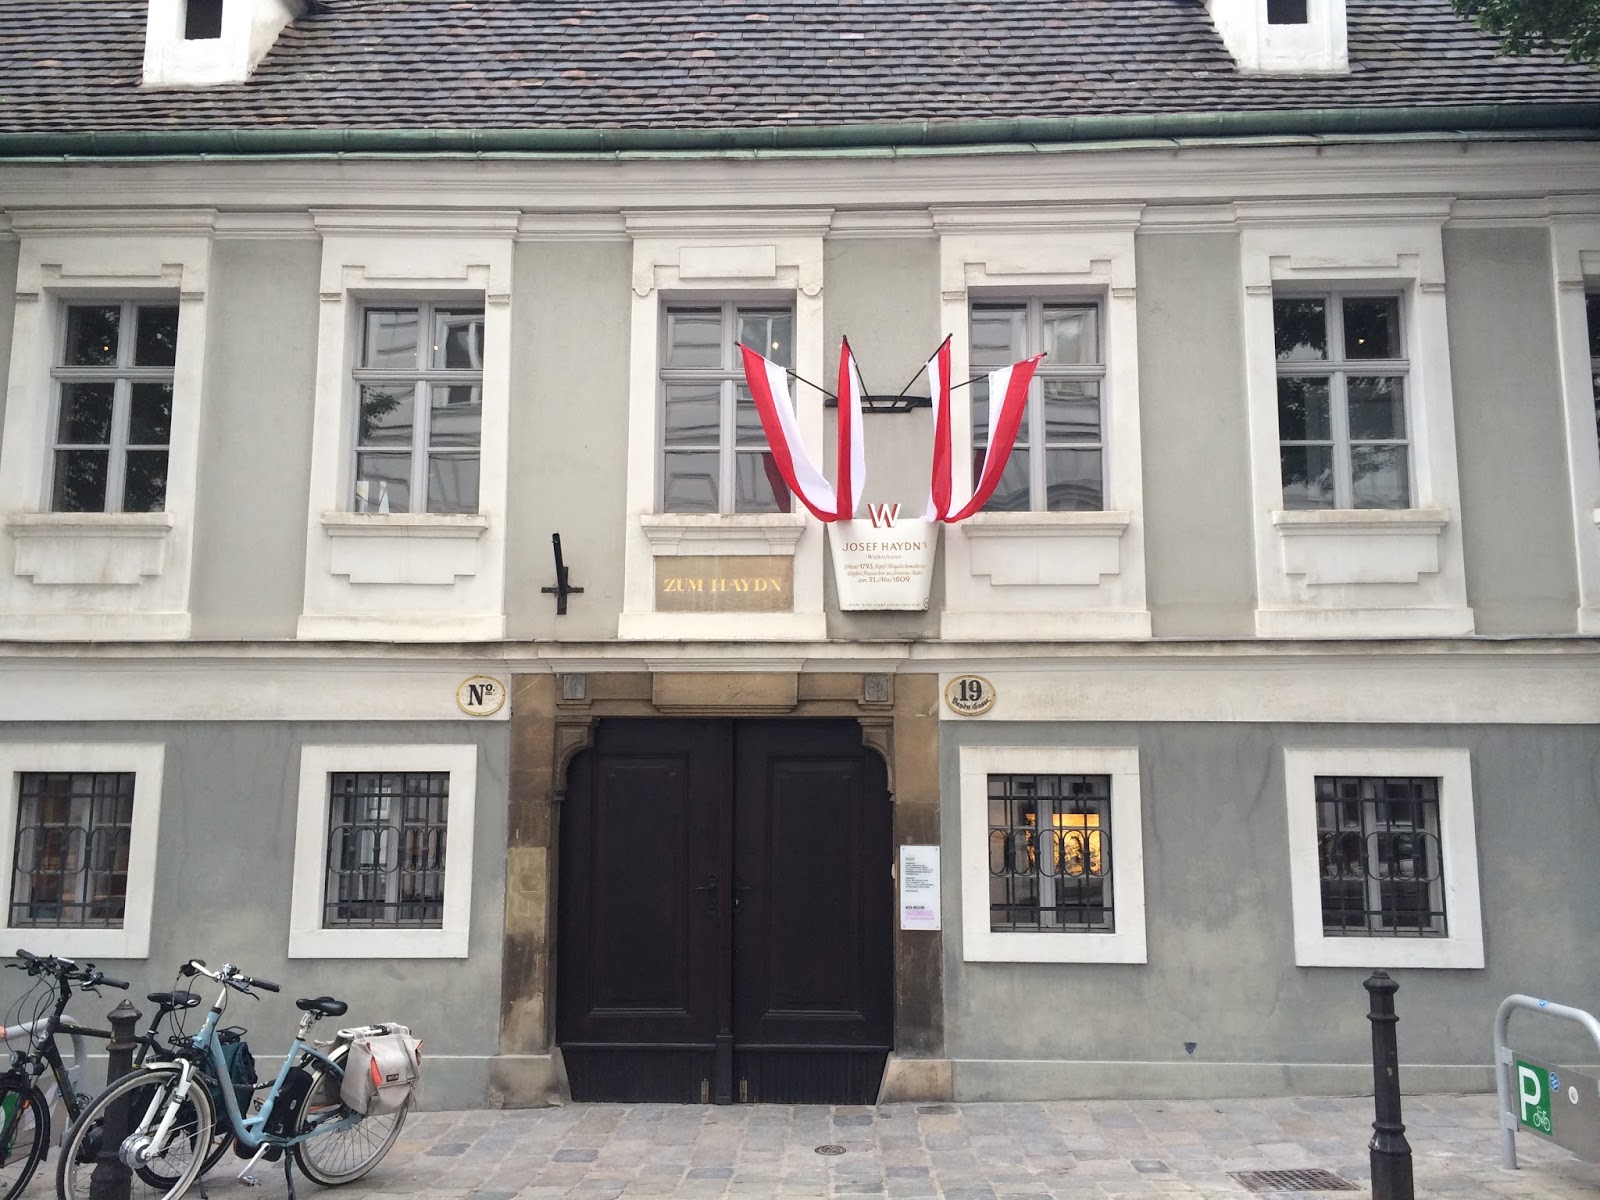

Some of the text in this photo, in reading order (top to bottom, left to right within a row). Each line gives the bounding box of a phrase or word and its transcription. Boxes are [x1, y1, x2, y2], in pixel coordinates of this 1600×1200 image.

[842, 542, 878, 551] JOSEF
[663, 576, 782, 592] ZUM HAYDN
[959, 679, 983, 702] 19
[1518, 1065, 1541, 1121] P
